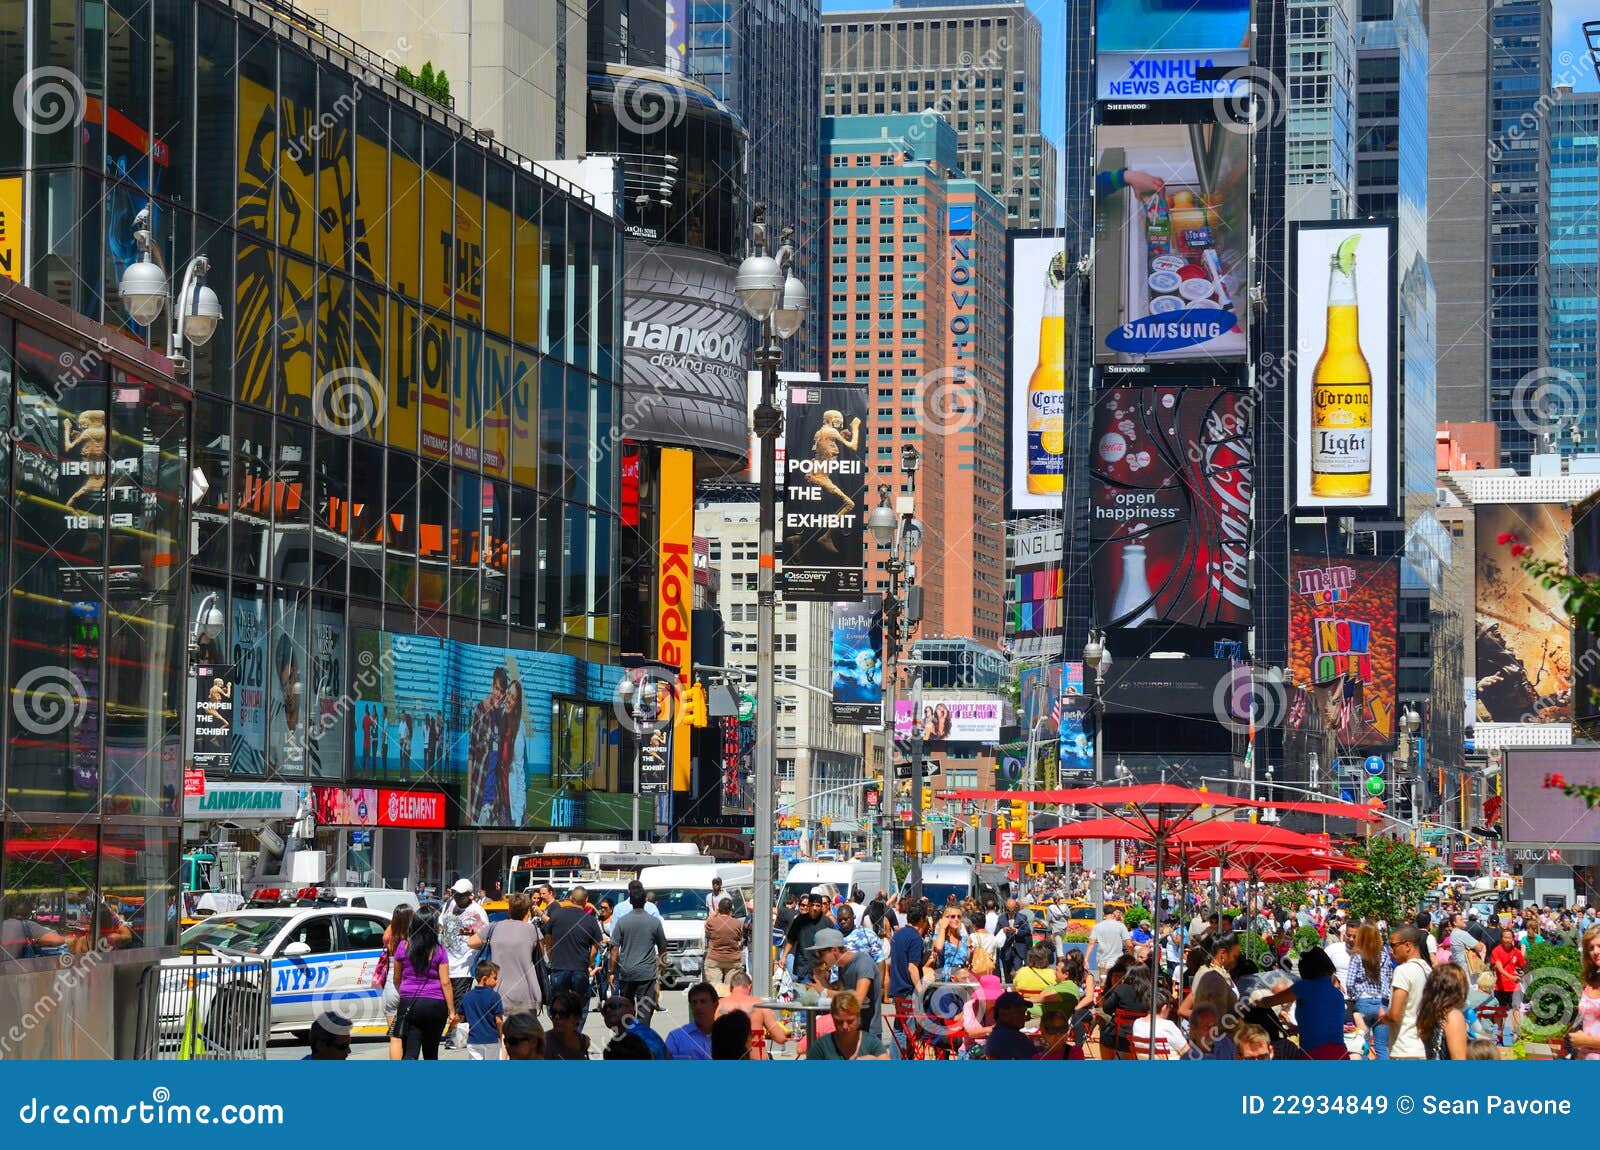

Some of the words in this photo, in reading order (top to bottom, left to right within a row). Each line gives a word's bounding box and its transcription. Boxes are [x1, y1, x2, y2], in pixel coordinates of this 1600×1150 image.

[1110, 81, 1160, 95] NEWS
[1165, 80, 1237, 95] AGENCY
[441, 231, 481, 297] THE
[950, 238, 969, 413] NOVOTEL
[1122, 322, 1221, 340] SAMSUNG
[397, 283, 461, 409] LION
[466, 313, 529, 429] KING
[650, 353, 703, 375] driving
[1315, 388, 1369, 408] Corona
[423, 433, 448, 452] ENTRANCE
[454, 443, 463, 457] ON
[1319, 431, 1366, 454] Light
[788, 459, 861, 475] POMPEII
[788, 486, 821, 501] THE
[1115, 493, 1155, 507] open
[787, 513, 856, 529] EXHIBIT
[661, 543, 689, 684] Koda
[1320, 620, 1370, 654] NOW
[1319, 653, 1372, 684] OPEN
[197, 702, 232, 710] POMPEII
[199, 791, 282, 810] LANDMARK
[399, 796, 436, 820] ELEMENT
[1002, 831, 1015, 859] tkts
[276, 966, 329, 992] NYPD
